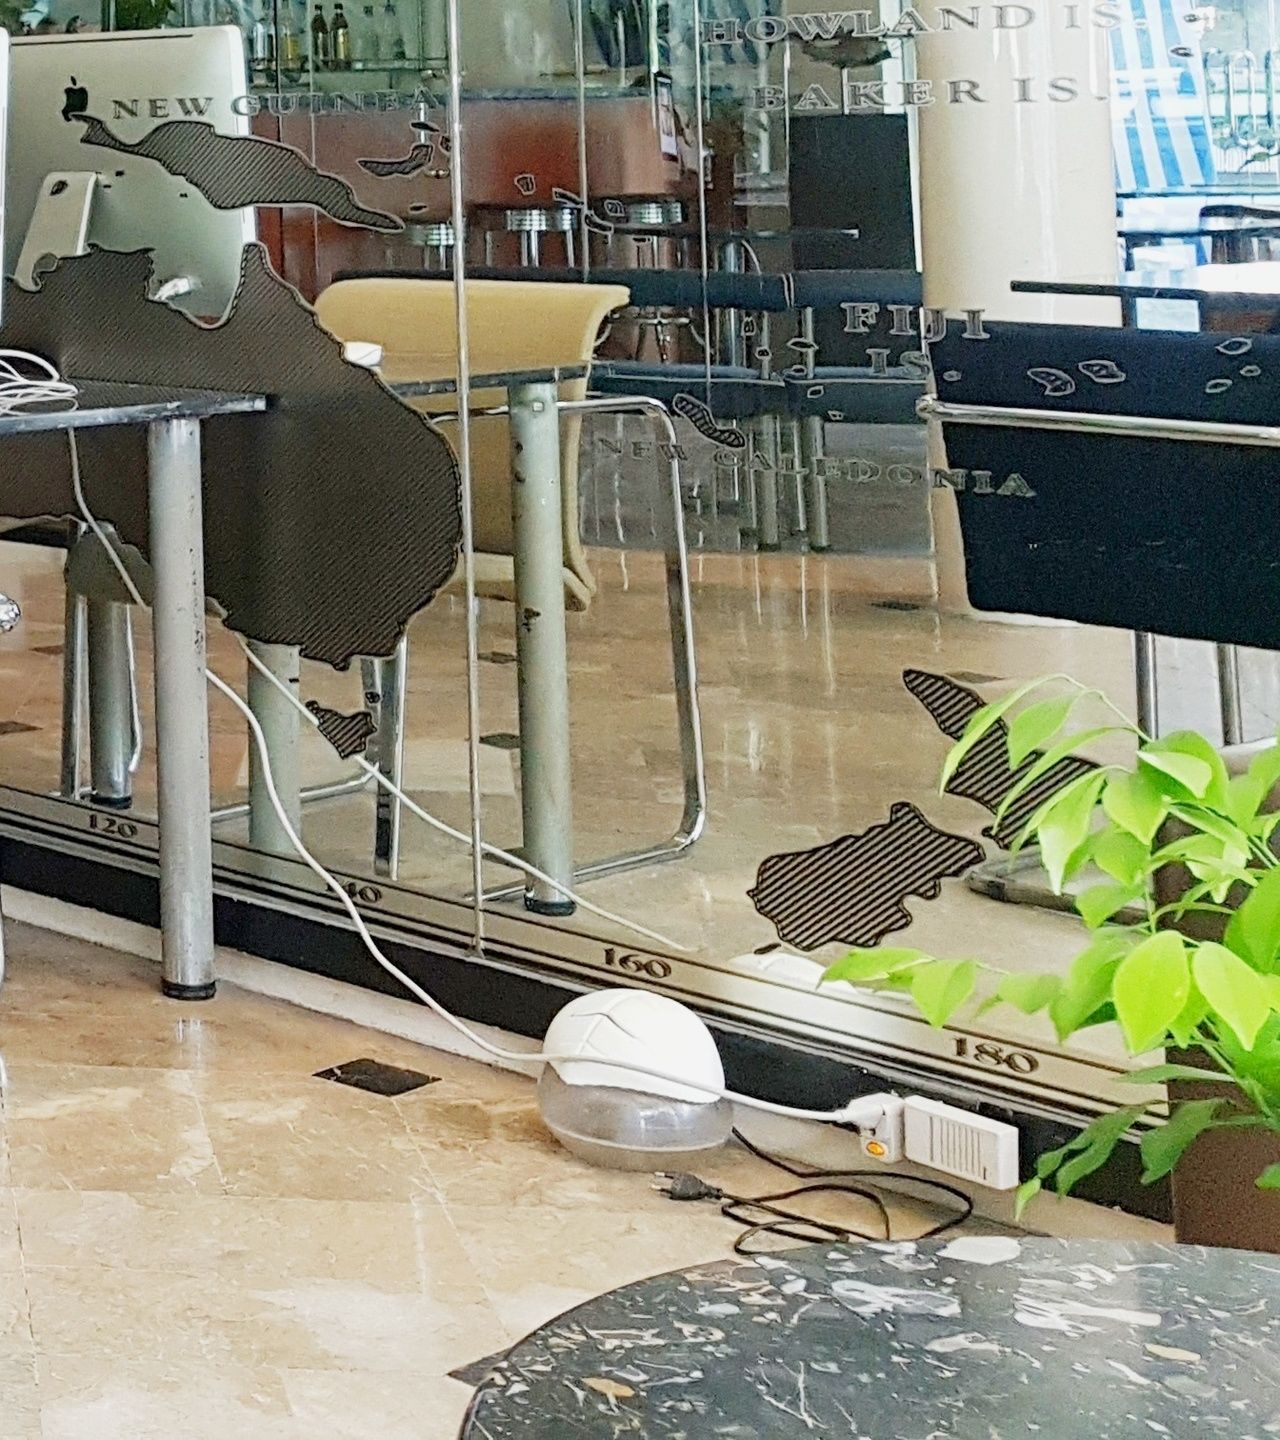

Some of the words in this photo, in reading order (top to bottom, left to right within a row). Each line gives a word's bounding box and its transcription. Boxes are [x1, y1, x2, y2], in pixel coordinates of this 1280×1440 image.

[700, 4, 1036, 46] HOWLAND
[1063, 1, 1149, 30] IS.
[111, 96, 215, 120] NEW
[230, 87, 441, 118] GUINEA
[752, 78, 986, 112] BAKER
[1014, 77, 1111, 104] IS.
[840, 302, 991, 343] FIJI
[88, 814, 138, 839] 120
[603, 946, 673, 979] 160
[953, 1036, 1040, 1074] 180
